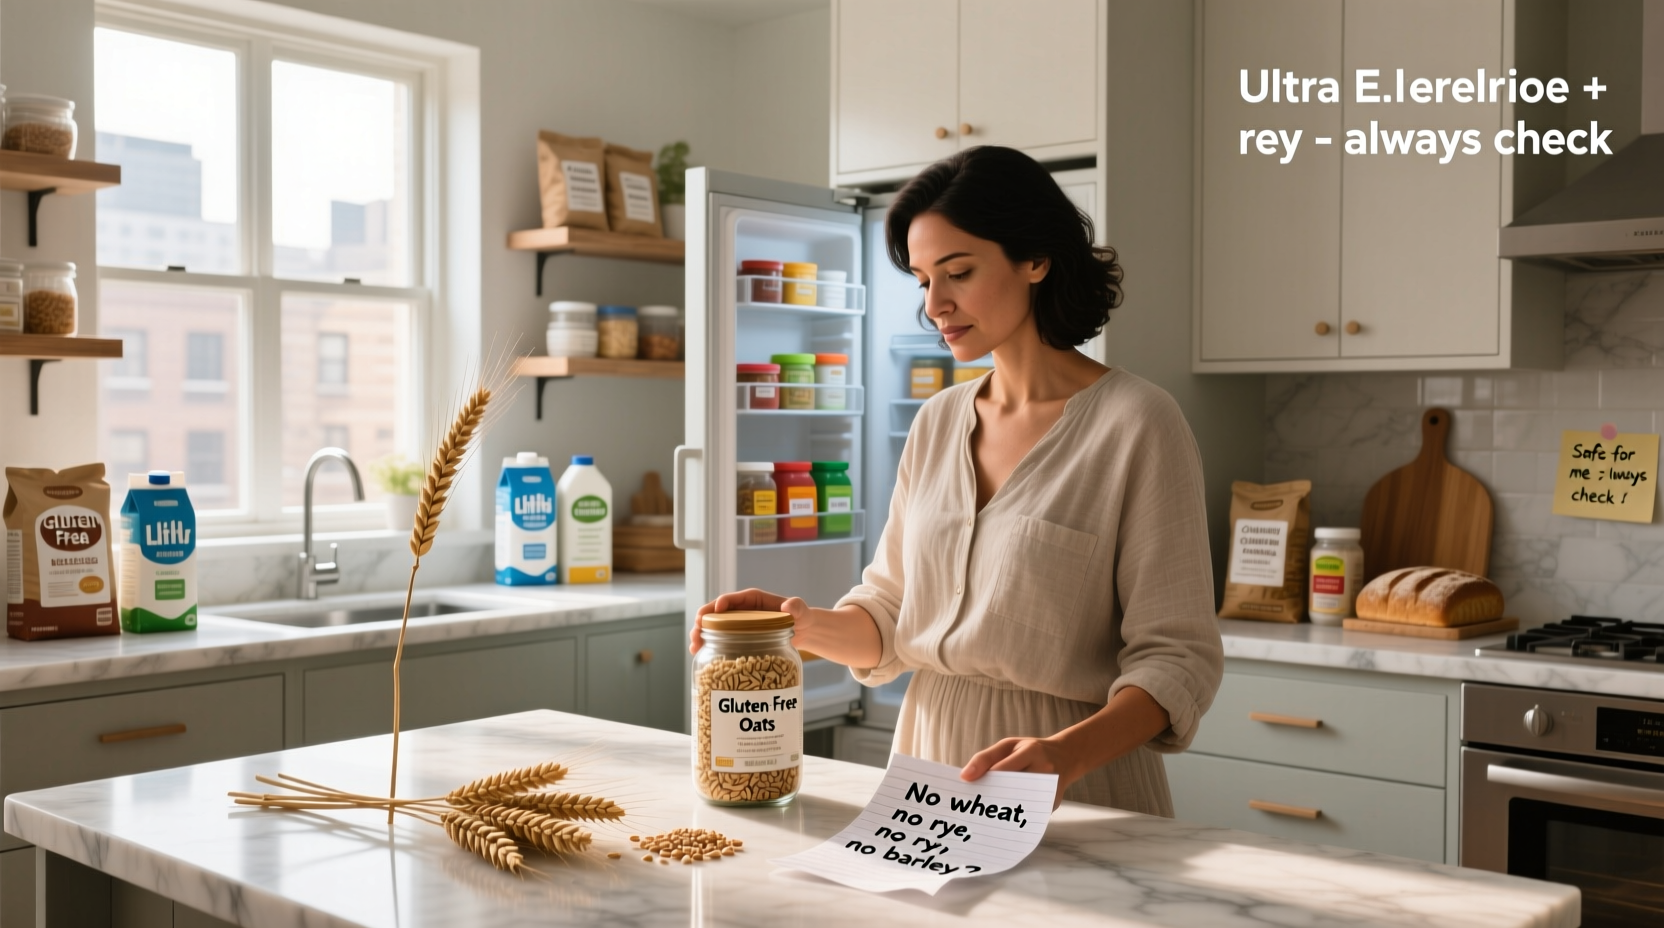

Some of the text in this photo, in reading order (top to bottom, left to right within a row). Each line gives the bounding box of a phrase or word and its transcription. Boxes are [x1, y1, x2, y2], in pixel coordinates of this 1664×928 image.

[1572, 443, 1636, 463] Safe for
[1569, 468, 1591, 480] me
[1571, 486, 1615, 505] check
[719, 697, 769, 713] Gluten
[739, 717, 775, 732] Oats
[905, 782, 1027, 828] No wheat,
[892, 808, 971, 842] no rye,
[875, 826, 949, 855] no ry,
[845, 840, 876, 855] no
[883, 846, 960, 875] barley
